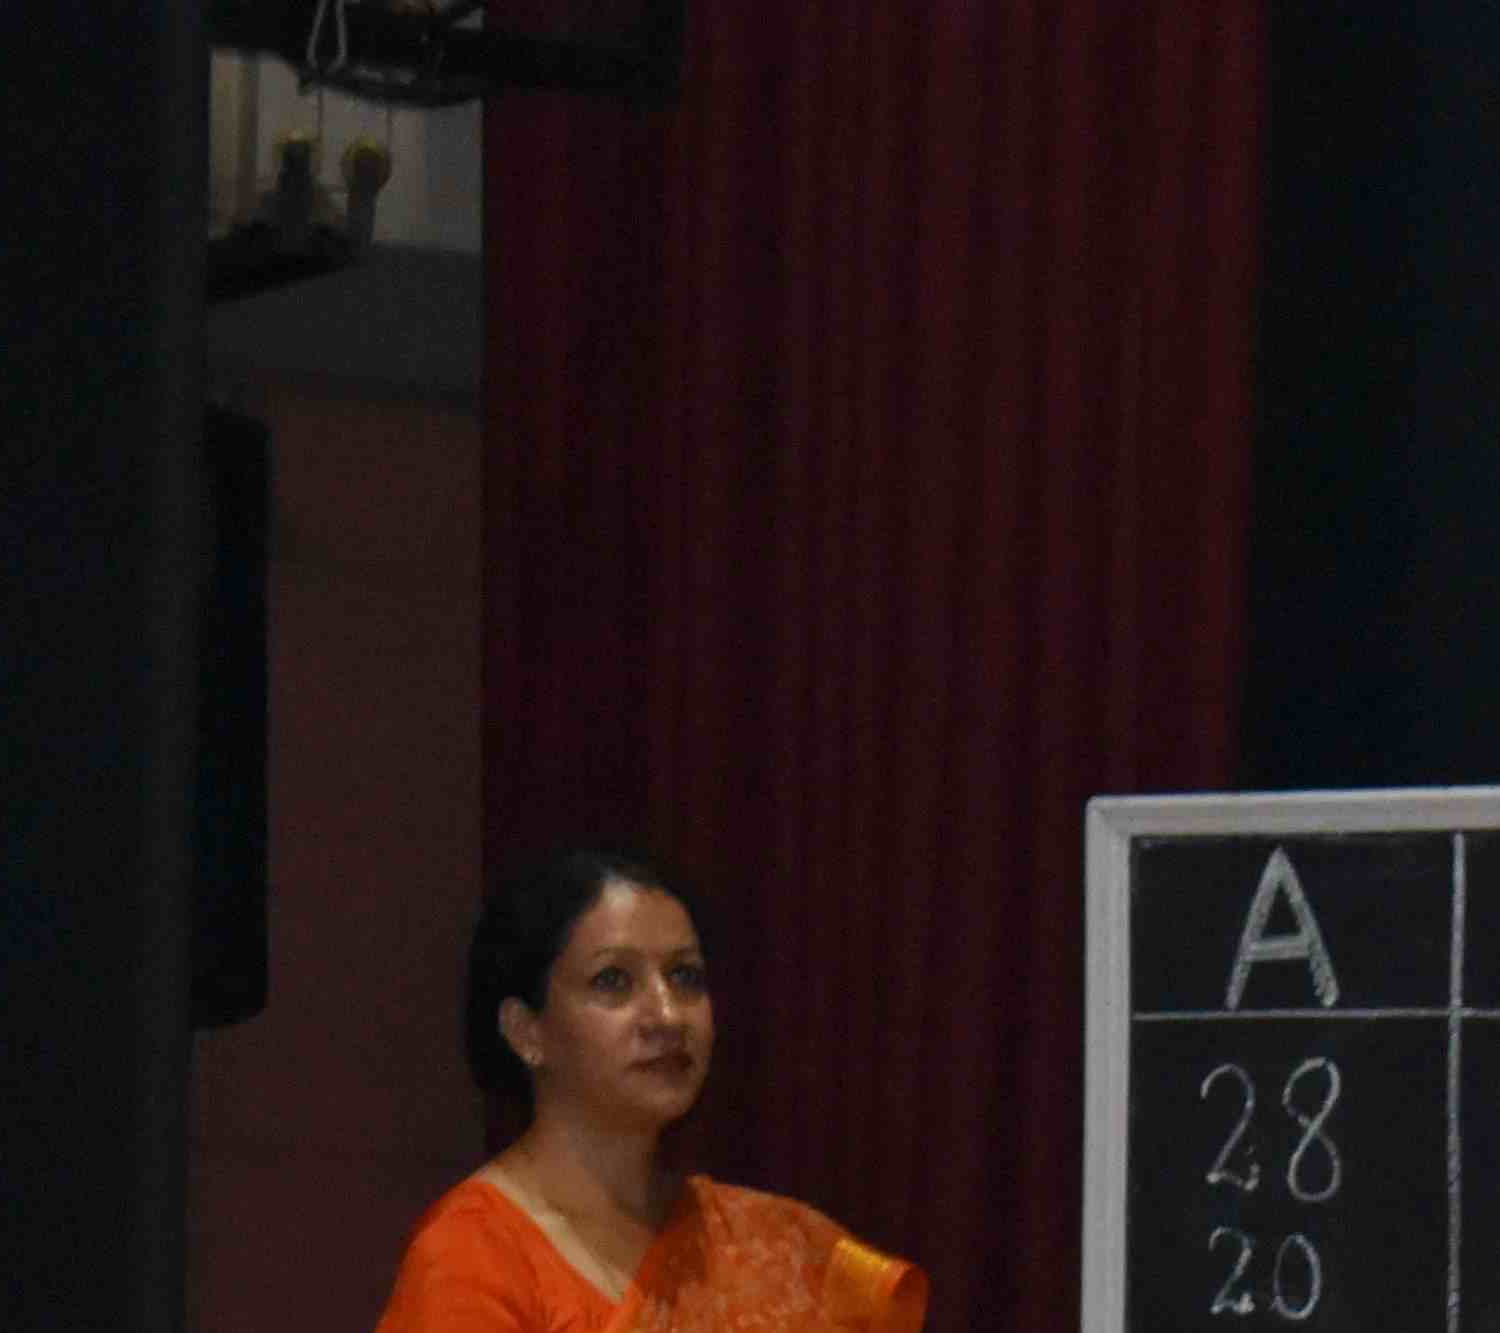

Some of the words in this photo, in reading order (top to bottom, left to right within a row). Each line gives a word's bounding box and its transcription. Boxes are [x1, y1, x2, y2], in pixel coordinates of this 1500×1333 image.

[1225, 846, 1340, 1010] A
[1200, 1056, 1342, 1202] 28
[1207, 1225, 1323, 1320] 20
